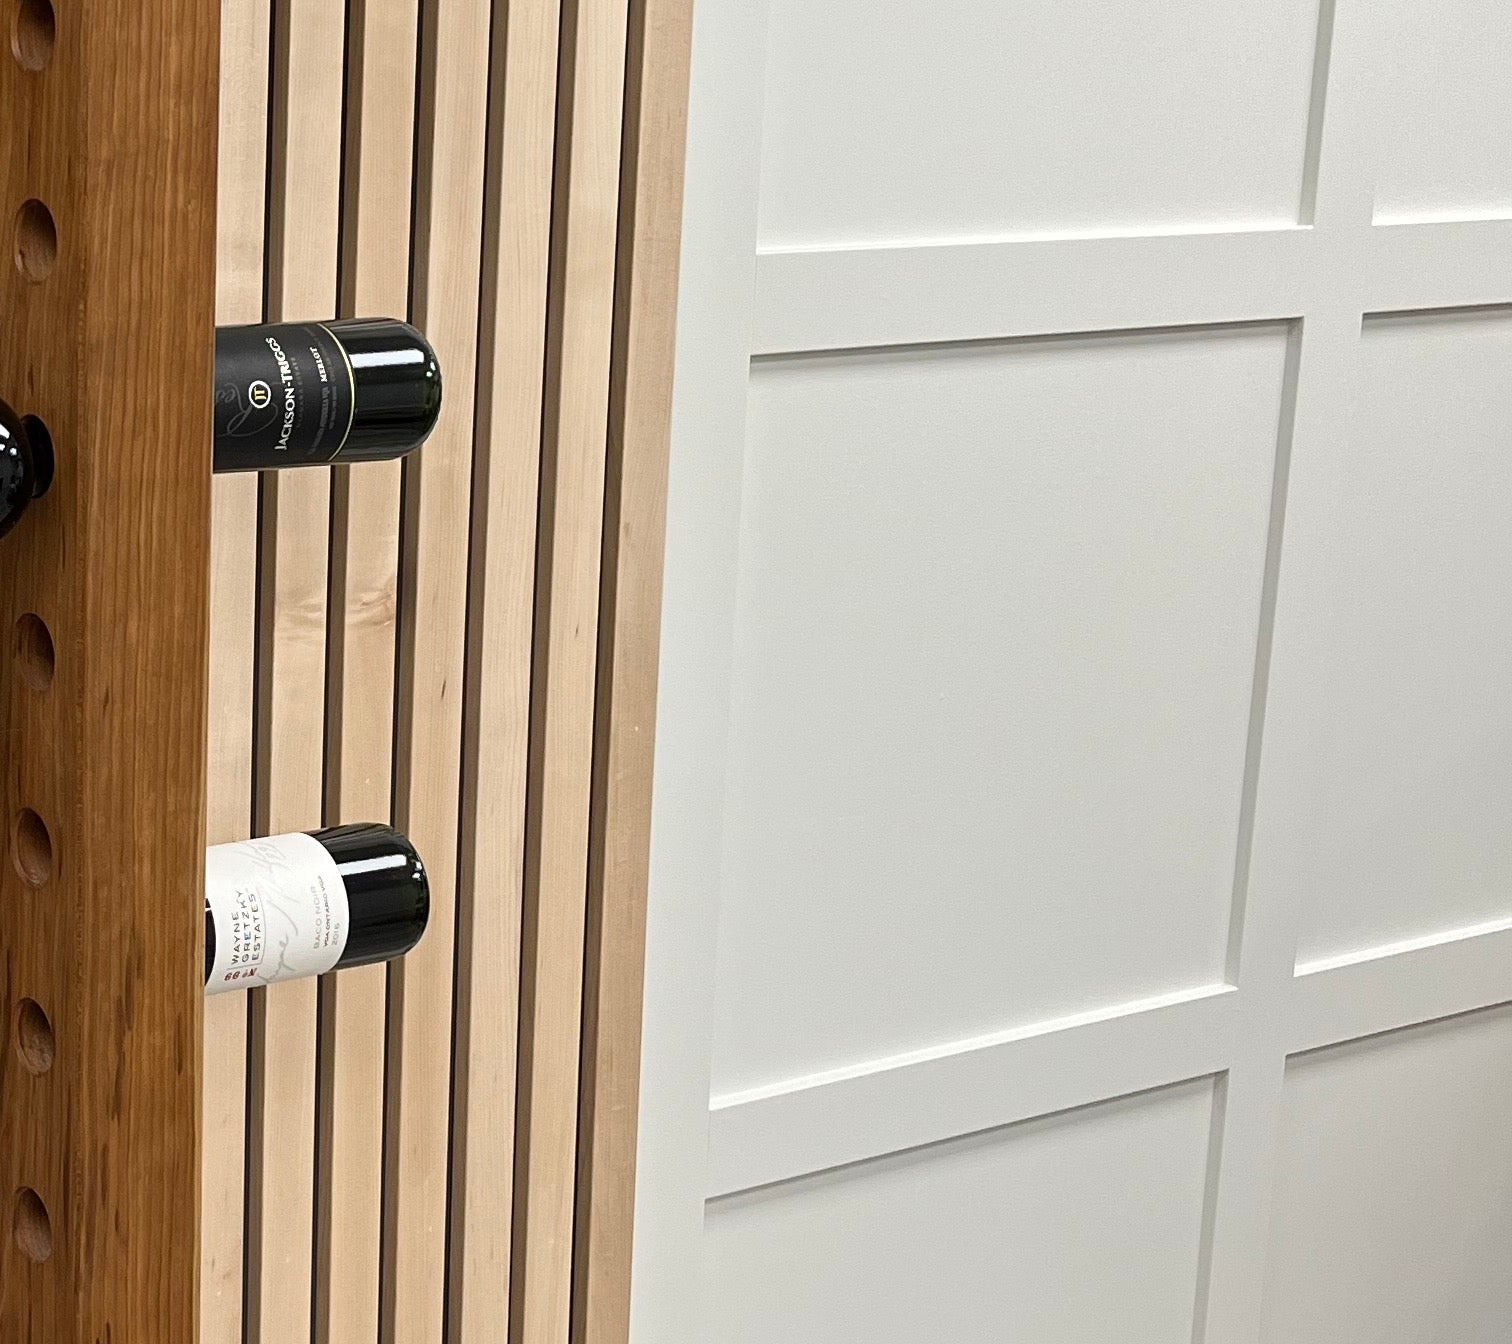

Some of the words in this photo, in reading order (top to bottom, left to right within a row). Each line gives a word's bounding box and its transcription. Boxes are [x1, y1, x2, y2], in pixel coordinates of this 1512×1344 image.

[265, 337, 295, 450] JACKSON-TRIGGS
[309, 346, 328, 383] MERLOT
[231, 912, 241, 965] WAYNE
[235, 889, 251, 962] GRETZKY
[249, 893, 261, 960] ESTATES
[313, 917, 323, 949] BACO
